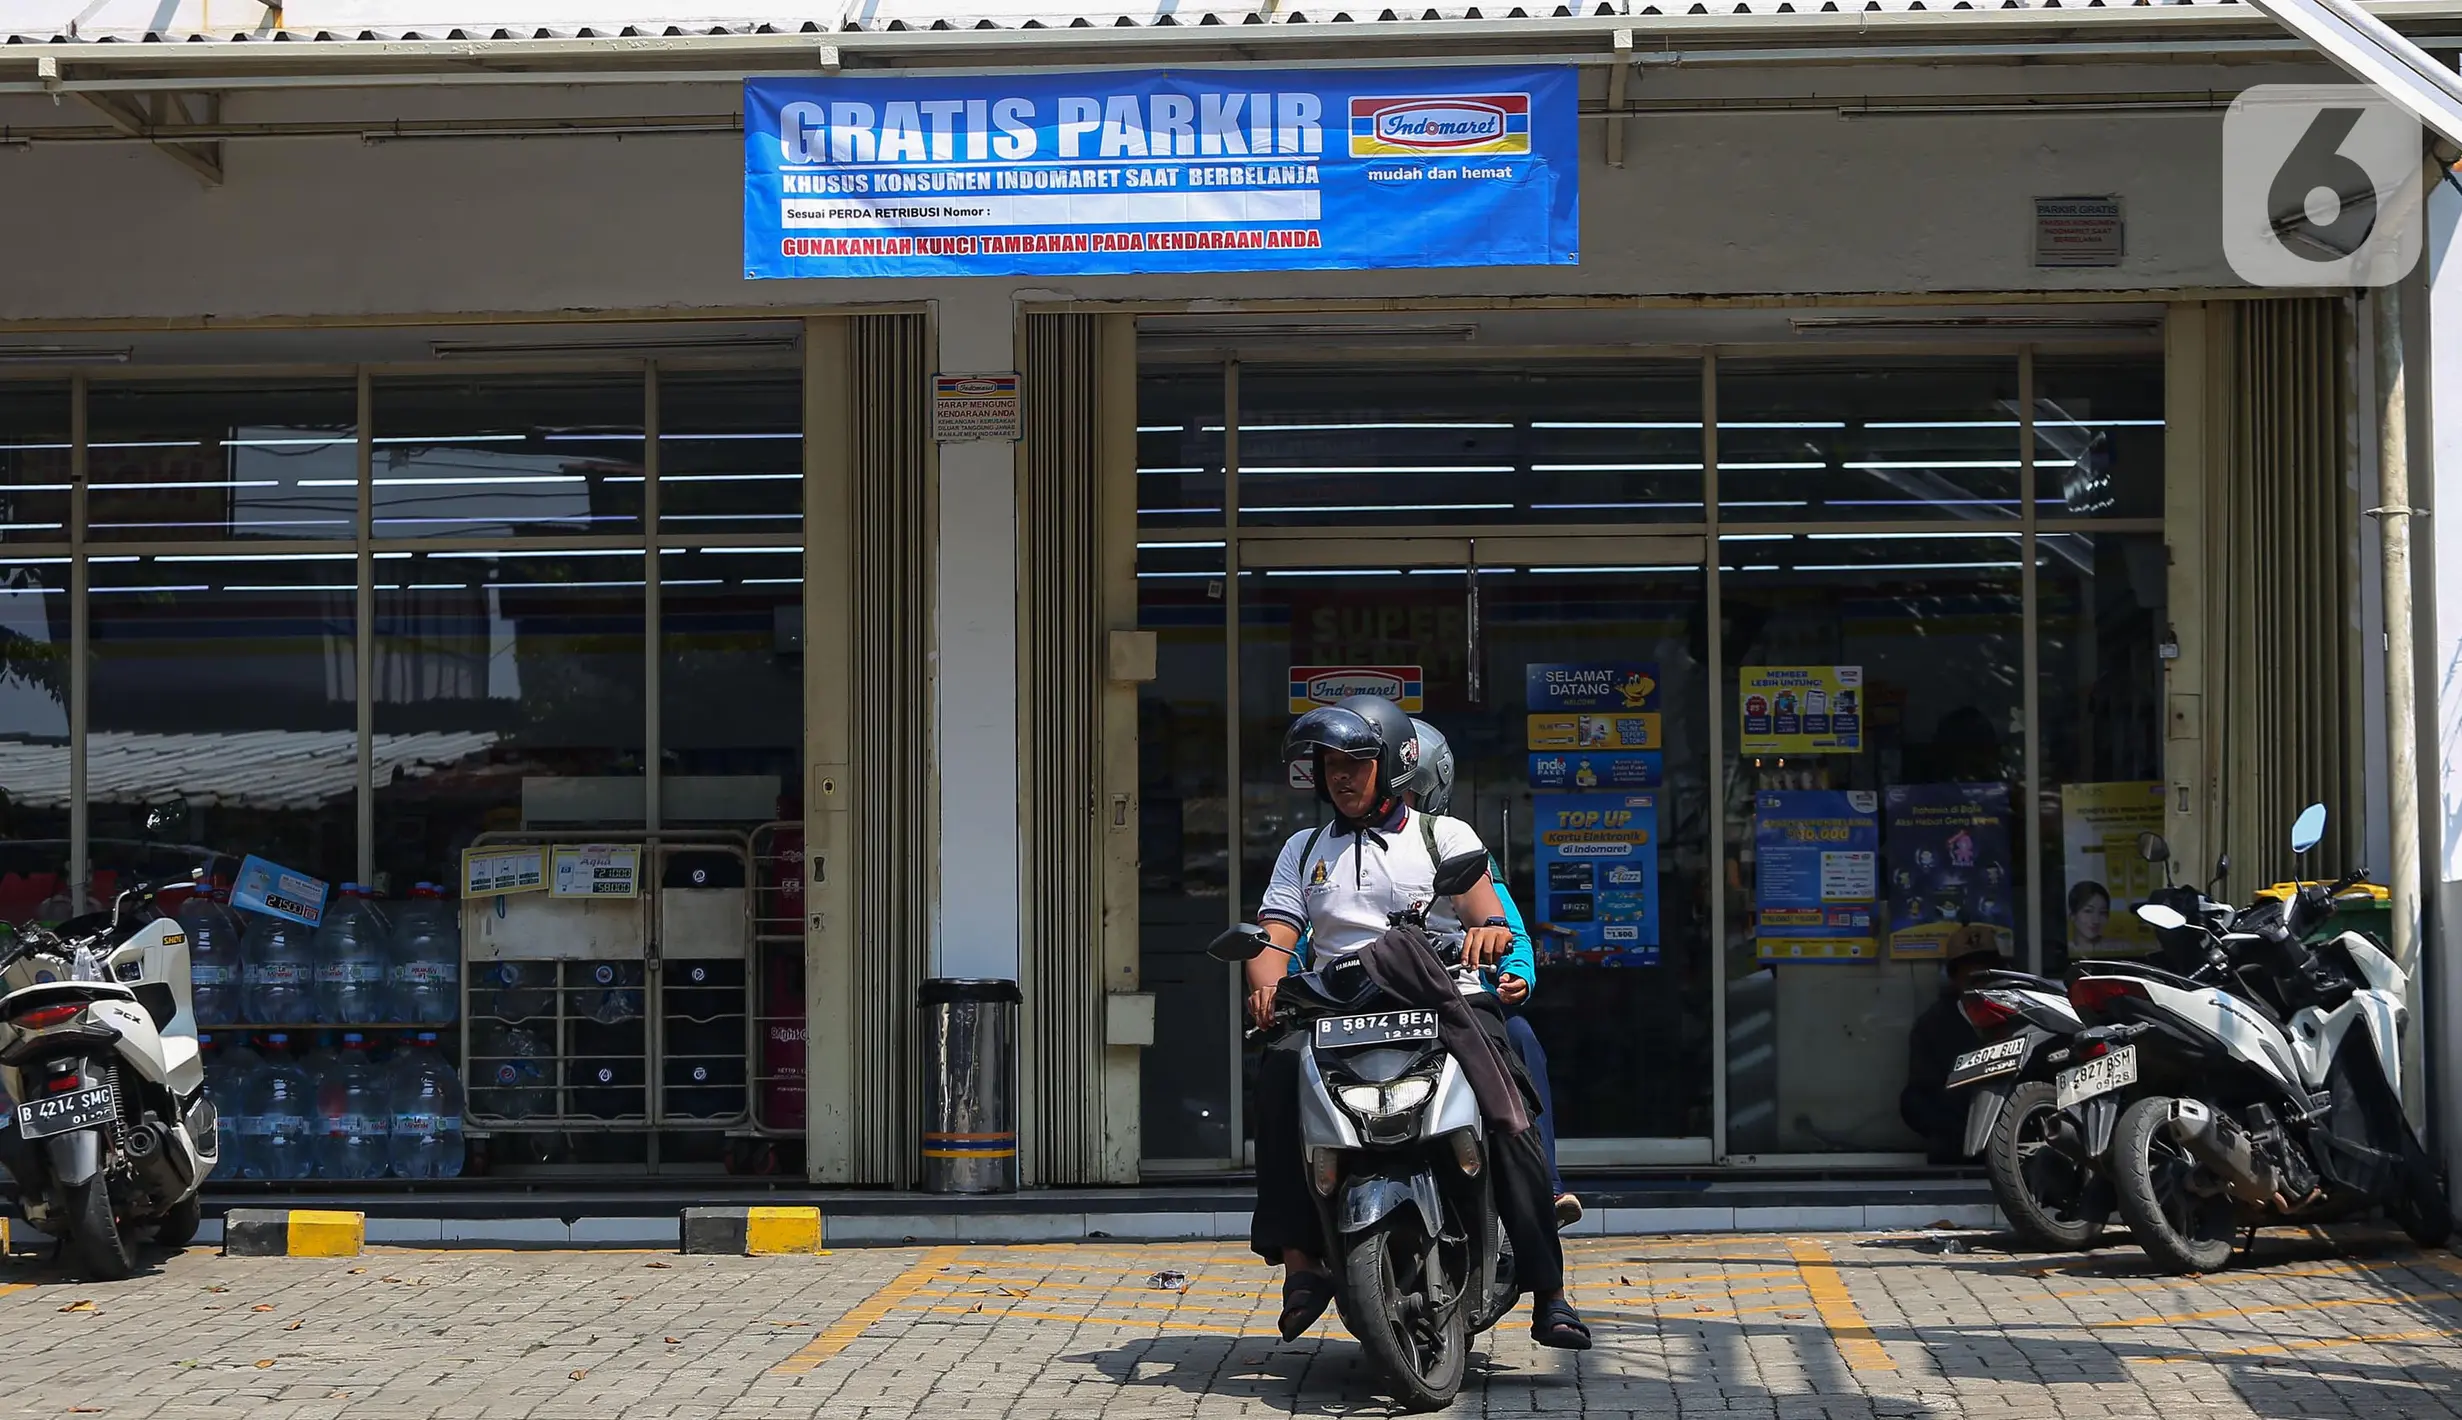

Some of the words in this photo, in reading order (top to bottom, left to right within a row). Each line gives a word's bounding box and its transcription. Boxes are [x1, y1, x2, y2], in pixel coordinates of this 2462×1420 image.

[779, 97, 1038, 163] GRATIS
[1058, 91, 1322, 160] PARKIR
[1383, 115, 1496, 136] Indomaret
[782, 173, 868, 194] KHUSUS
[874, 171, 991, 193] KONSUMEN
[996, 170, 1120, 191] INDOMARET
[1126, 168, 1178, 188] SAAT
[1188, 165, 1320, 186] BERBELANJA
[1368, 168, 1422, 181] mudah
[1427, 167, 1458, 181] dan
[1461, 166, 1513, 179] hemat
[786, 208, 826, 219] Sesuai
[828, 208, 872, 219] PERDA
[875, 207, 940, 218] RETRIBUSI
[943, 206, 984, 217] Nomor
[2038, 205, 2077, 214] PARKIR
[2079, 205, 2118, 214] GRATIS
[782, 236, 912, 256] GUNAKANLAH
[915, 235, 979, 255] KUNCI
[982, 234, 1088, 254] TAMBAHAN
[1092, 233, 1144, 252] PADA
[1147, 230, 1264, 251] KENDARAAN
[1265, 229, 1321, 249] ANDA
[970, 400, 1016, 408] MENGUNCI
[1312, 605, 1465, 643] SUPER
[1545, 670, 1614, 683] SELAMAT
[1313, 681, 1397, 697] Indomaret
[1550, 683, 1610, 695] DATANG
[1557, 811, 1599, 828] TOP
[1604, 810, 1632, 828] UP
[1563, 845, 1573, 854] di
[1574, 844, 1627, 853] Indomaret
[580, 858, 611, 867] Aqua
[1335, 959, 1360, 972] YAMAHA
[1321, 1020, 1332, 1033] B
[1342, 1015, 1389, 1032] 5874
[1398, 1012, 1434, 1026] BEA
[1956, 1056, 1964, 1070] B
[2059, 1074, 2067, 1090] B
[2073, 1060, 2103, 1083] 4827
[2106, 1050, 2130, 1072] BSM
[22, 1106, 33, 1122] B
[39, 1096, 75, 1118] 4214
